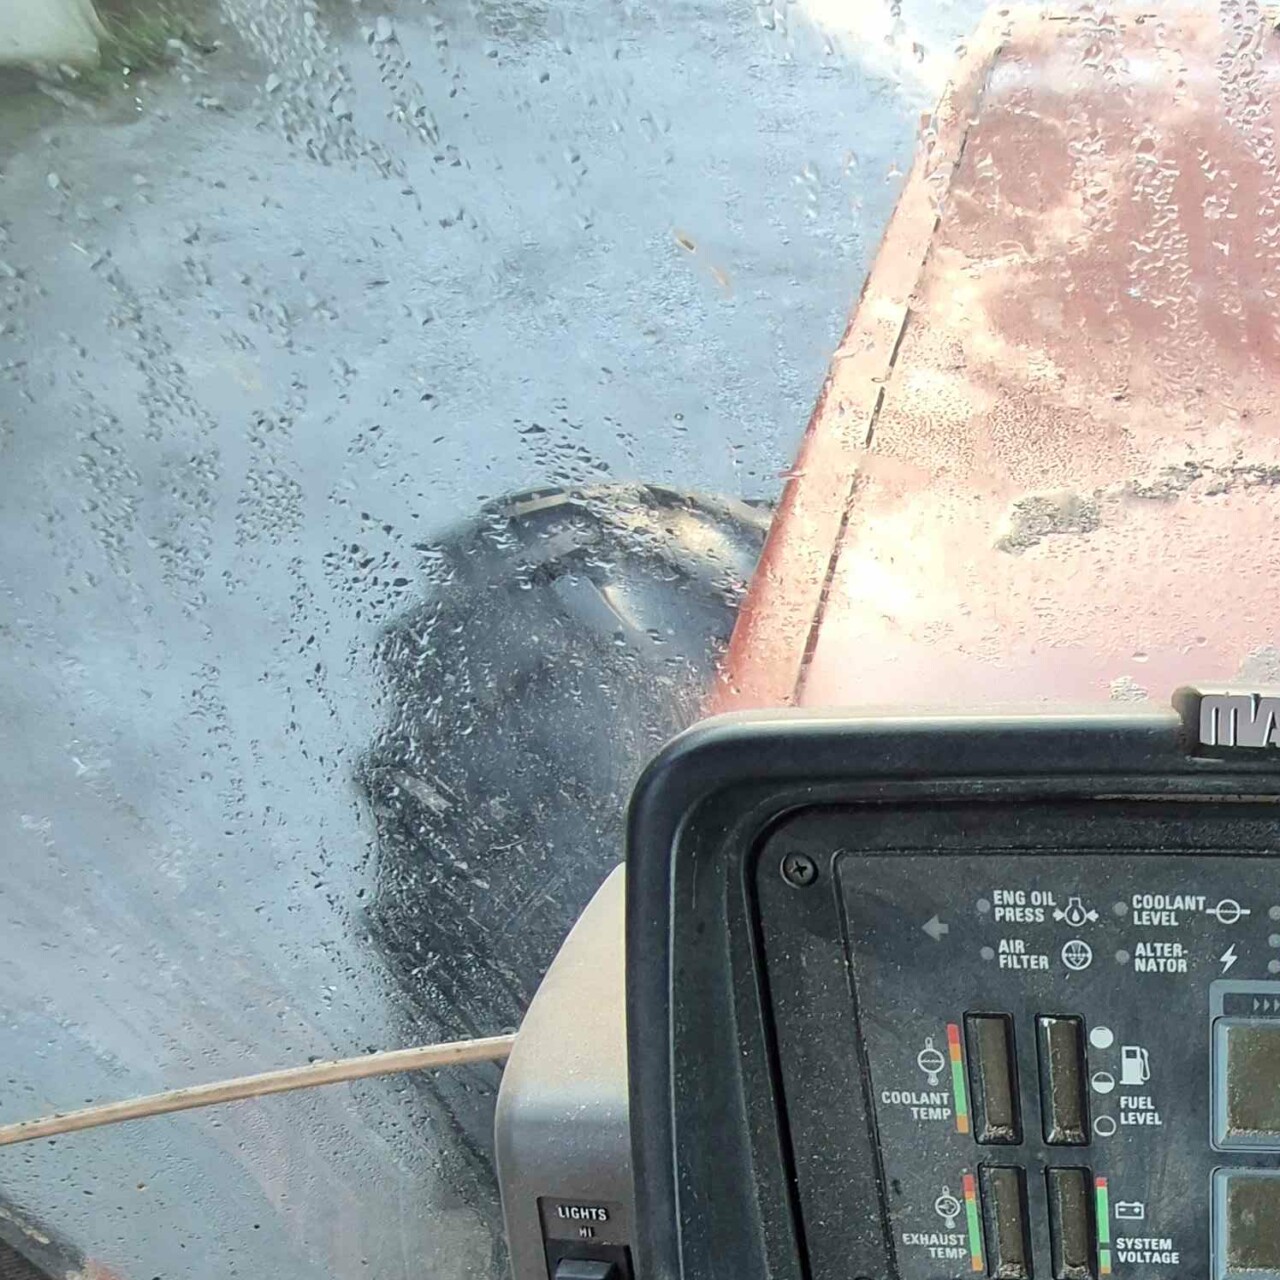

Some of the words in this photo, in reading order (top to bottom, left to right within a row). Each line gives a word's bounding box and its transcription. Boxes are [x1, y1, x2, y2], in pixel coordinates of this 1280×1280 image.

[993, 890, 1025, 906] ENG
[1030, 891, 1056, 906] OIL
[1132, 895, 1206, 911] COOLANT
[995, 908, 1044, 922] PRESS
[1134, 911, 1179, 926] LEVEL
[998, 939, 1025, 954] AIR
[1135, 943, 1188, 957] ALTER-
[1000, 955, 1049, 969] FILTER
[1135, 958, 1187, 973] NATOR
[882, 1092, 950, 1105] COOLANT
[1120, 1097, 1155, 1109] FUEL
[910, 1107, 952, 1120] TEMP
[1120, 1112, 1162, 1125] LEVEL
[557, 1206, 608, 1221] LIGHTS
[579, 1226, 593, 1239] HI
[902, 1233, 966, 1246] EXHAUST
[1116, 1238, 1173, 1251] SYSTEM
[928, 1247, 968, 1260] TEMP
[1117, 1252, 1179, 1264] VOLTAGE
